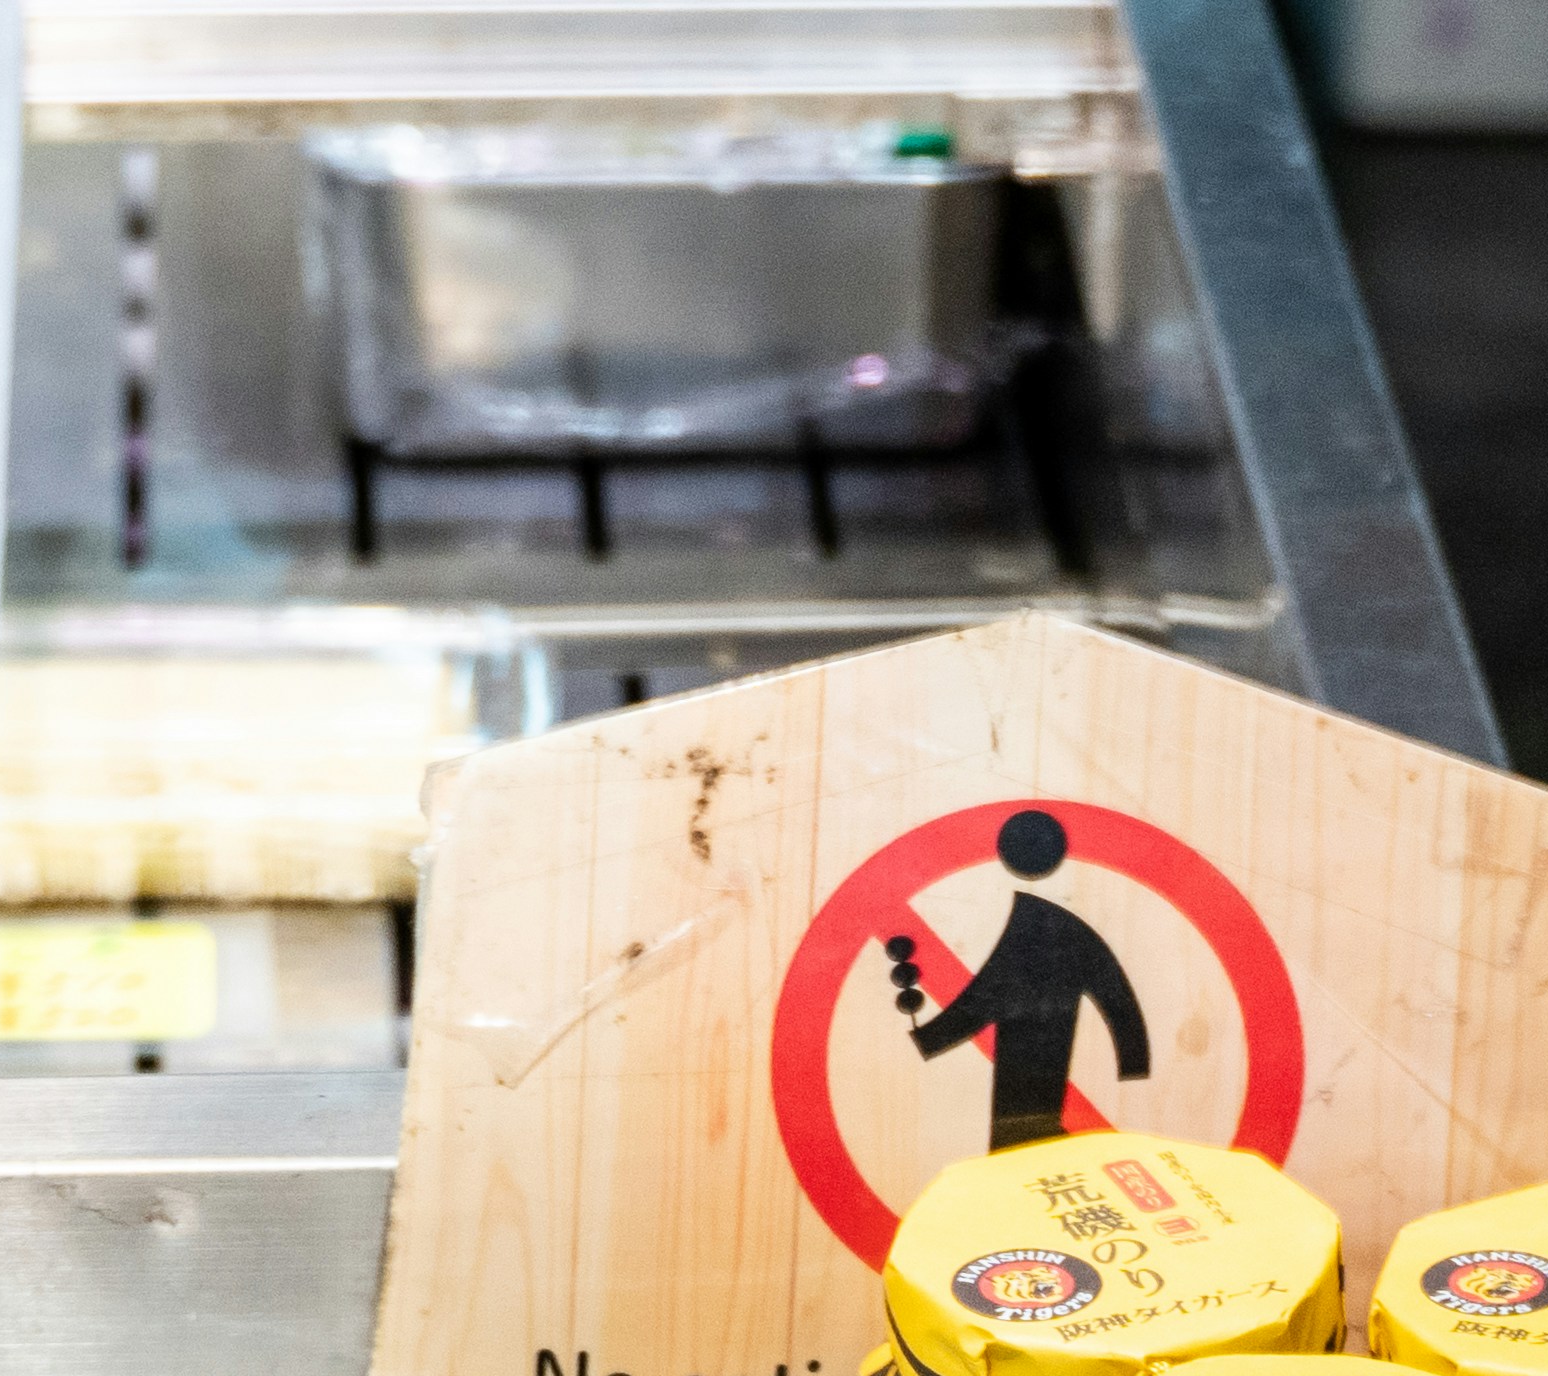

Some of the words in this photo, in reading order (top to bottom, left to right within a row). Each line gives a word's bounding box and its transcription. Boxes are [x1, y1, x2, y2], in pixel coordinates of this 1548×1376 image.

[956, 1249, 1067, 1287] HANSHIN
[995, 1291, 1094, 1321] Tigers
[1056, 1279, 1288, 1342] 阪神タイガース
[1429, 1289, 1531, 1316] Tigers
